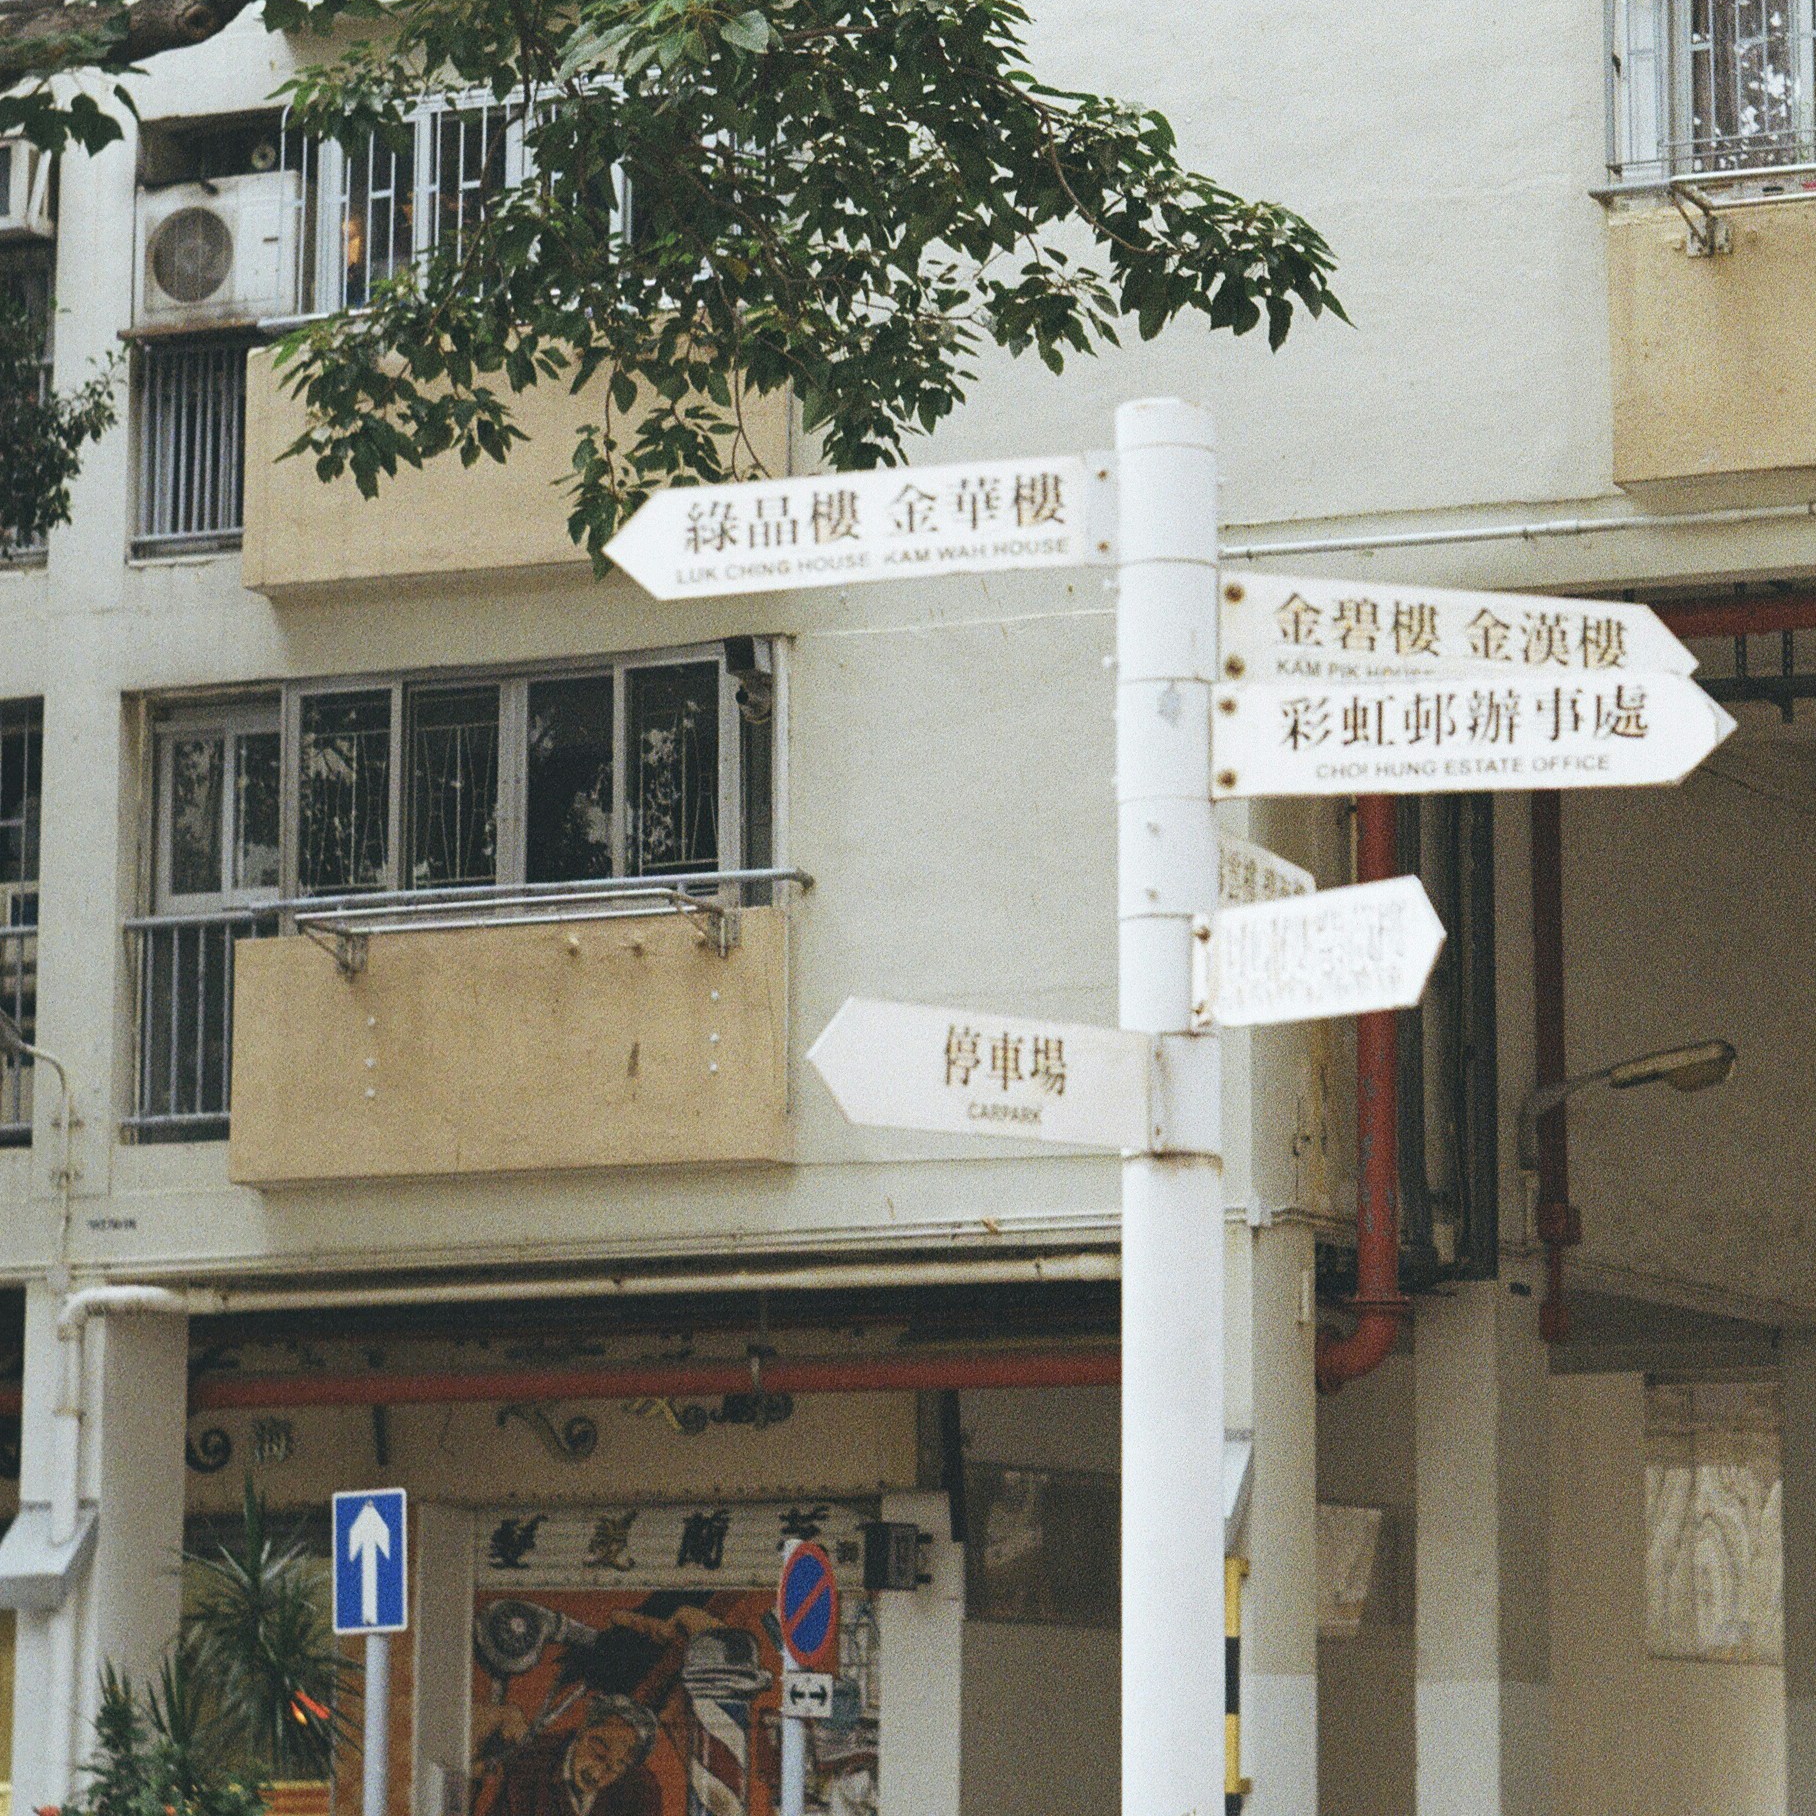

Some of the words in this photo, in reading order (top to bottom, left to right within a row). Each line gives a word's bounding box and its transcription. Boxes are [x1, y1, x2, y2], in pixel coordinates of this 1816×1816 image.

[888, 471, 1066, 535] 金華樓
[675, 567, 718, 584] LUK
[724, 558, 791, 581] CHING
[797, 550, 870, 571] HOUSE
[882, 548, 932, 566] KAM
[937, 543, 988, 562] WAH
[993, 536, 1070, 557] HOUSE
[1275, 591, 1442, 658] 金碧樓
[1464, 607, 1629, 671] 金漢樓
[1276, 659, 1322, 677] KAM
[1281, 684, 1649, 752] 彩虹邨辦事處
[1315, 761, 1367, 780] CHOI
[1375, 759, 1437, 779] HUNG
[1443, 757, 1524, 776] ESTATE
[1531, 753, 1611, 773] OFFICE
[945, 1023, 1068, 1096] 停車場
[967, 1101, 1043, 1125] CARPARK
